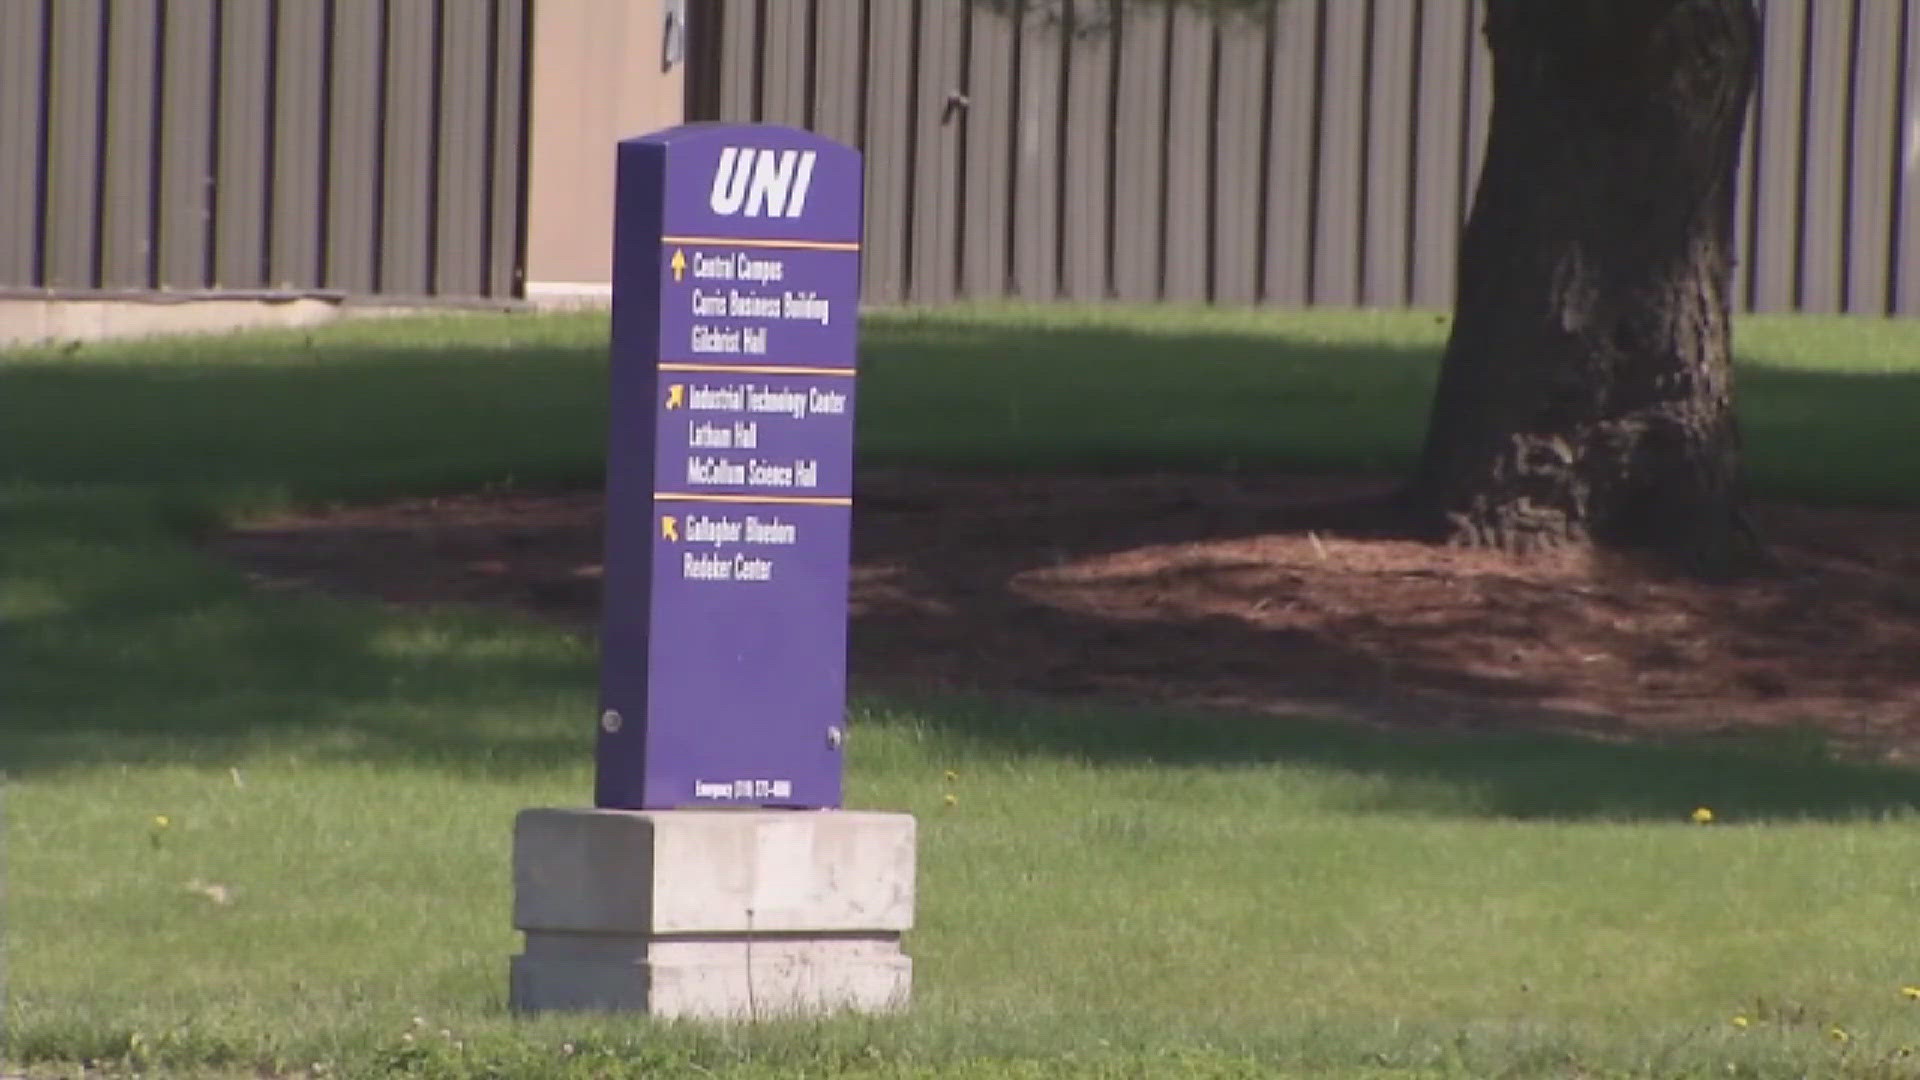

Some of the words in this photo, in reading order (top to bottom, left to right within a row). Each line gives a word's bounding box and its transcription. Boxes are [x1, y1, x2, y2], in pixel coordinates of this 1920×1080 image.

[710, 147, 816, 218] UNI
[693, 252, 735, 279] Central
[738, 253, 783, 286] Campus
[730, 290, 780, 318] Business
[784, 292, 829, 325] Building
[743, 328, 767, 355] Hall
[689, 384, 744, 410] Industrial
[747, 384, 807, 419] Technology
[810, 387, 846, 413] Center
[734, 421, 757, 449] Hall
[749, 459, 792, 487] Science
[795, 460, 817, 487] Hall
[735, 553, 772, 581] Center
